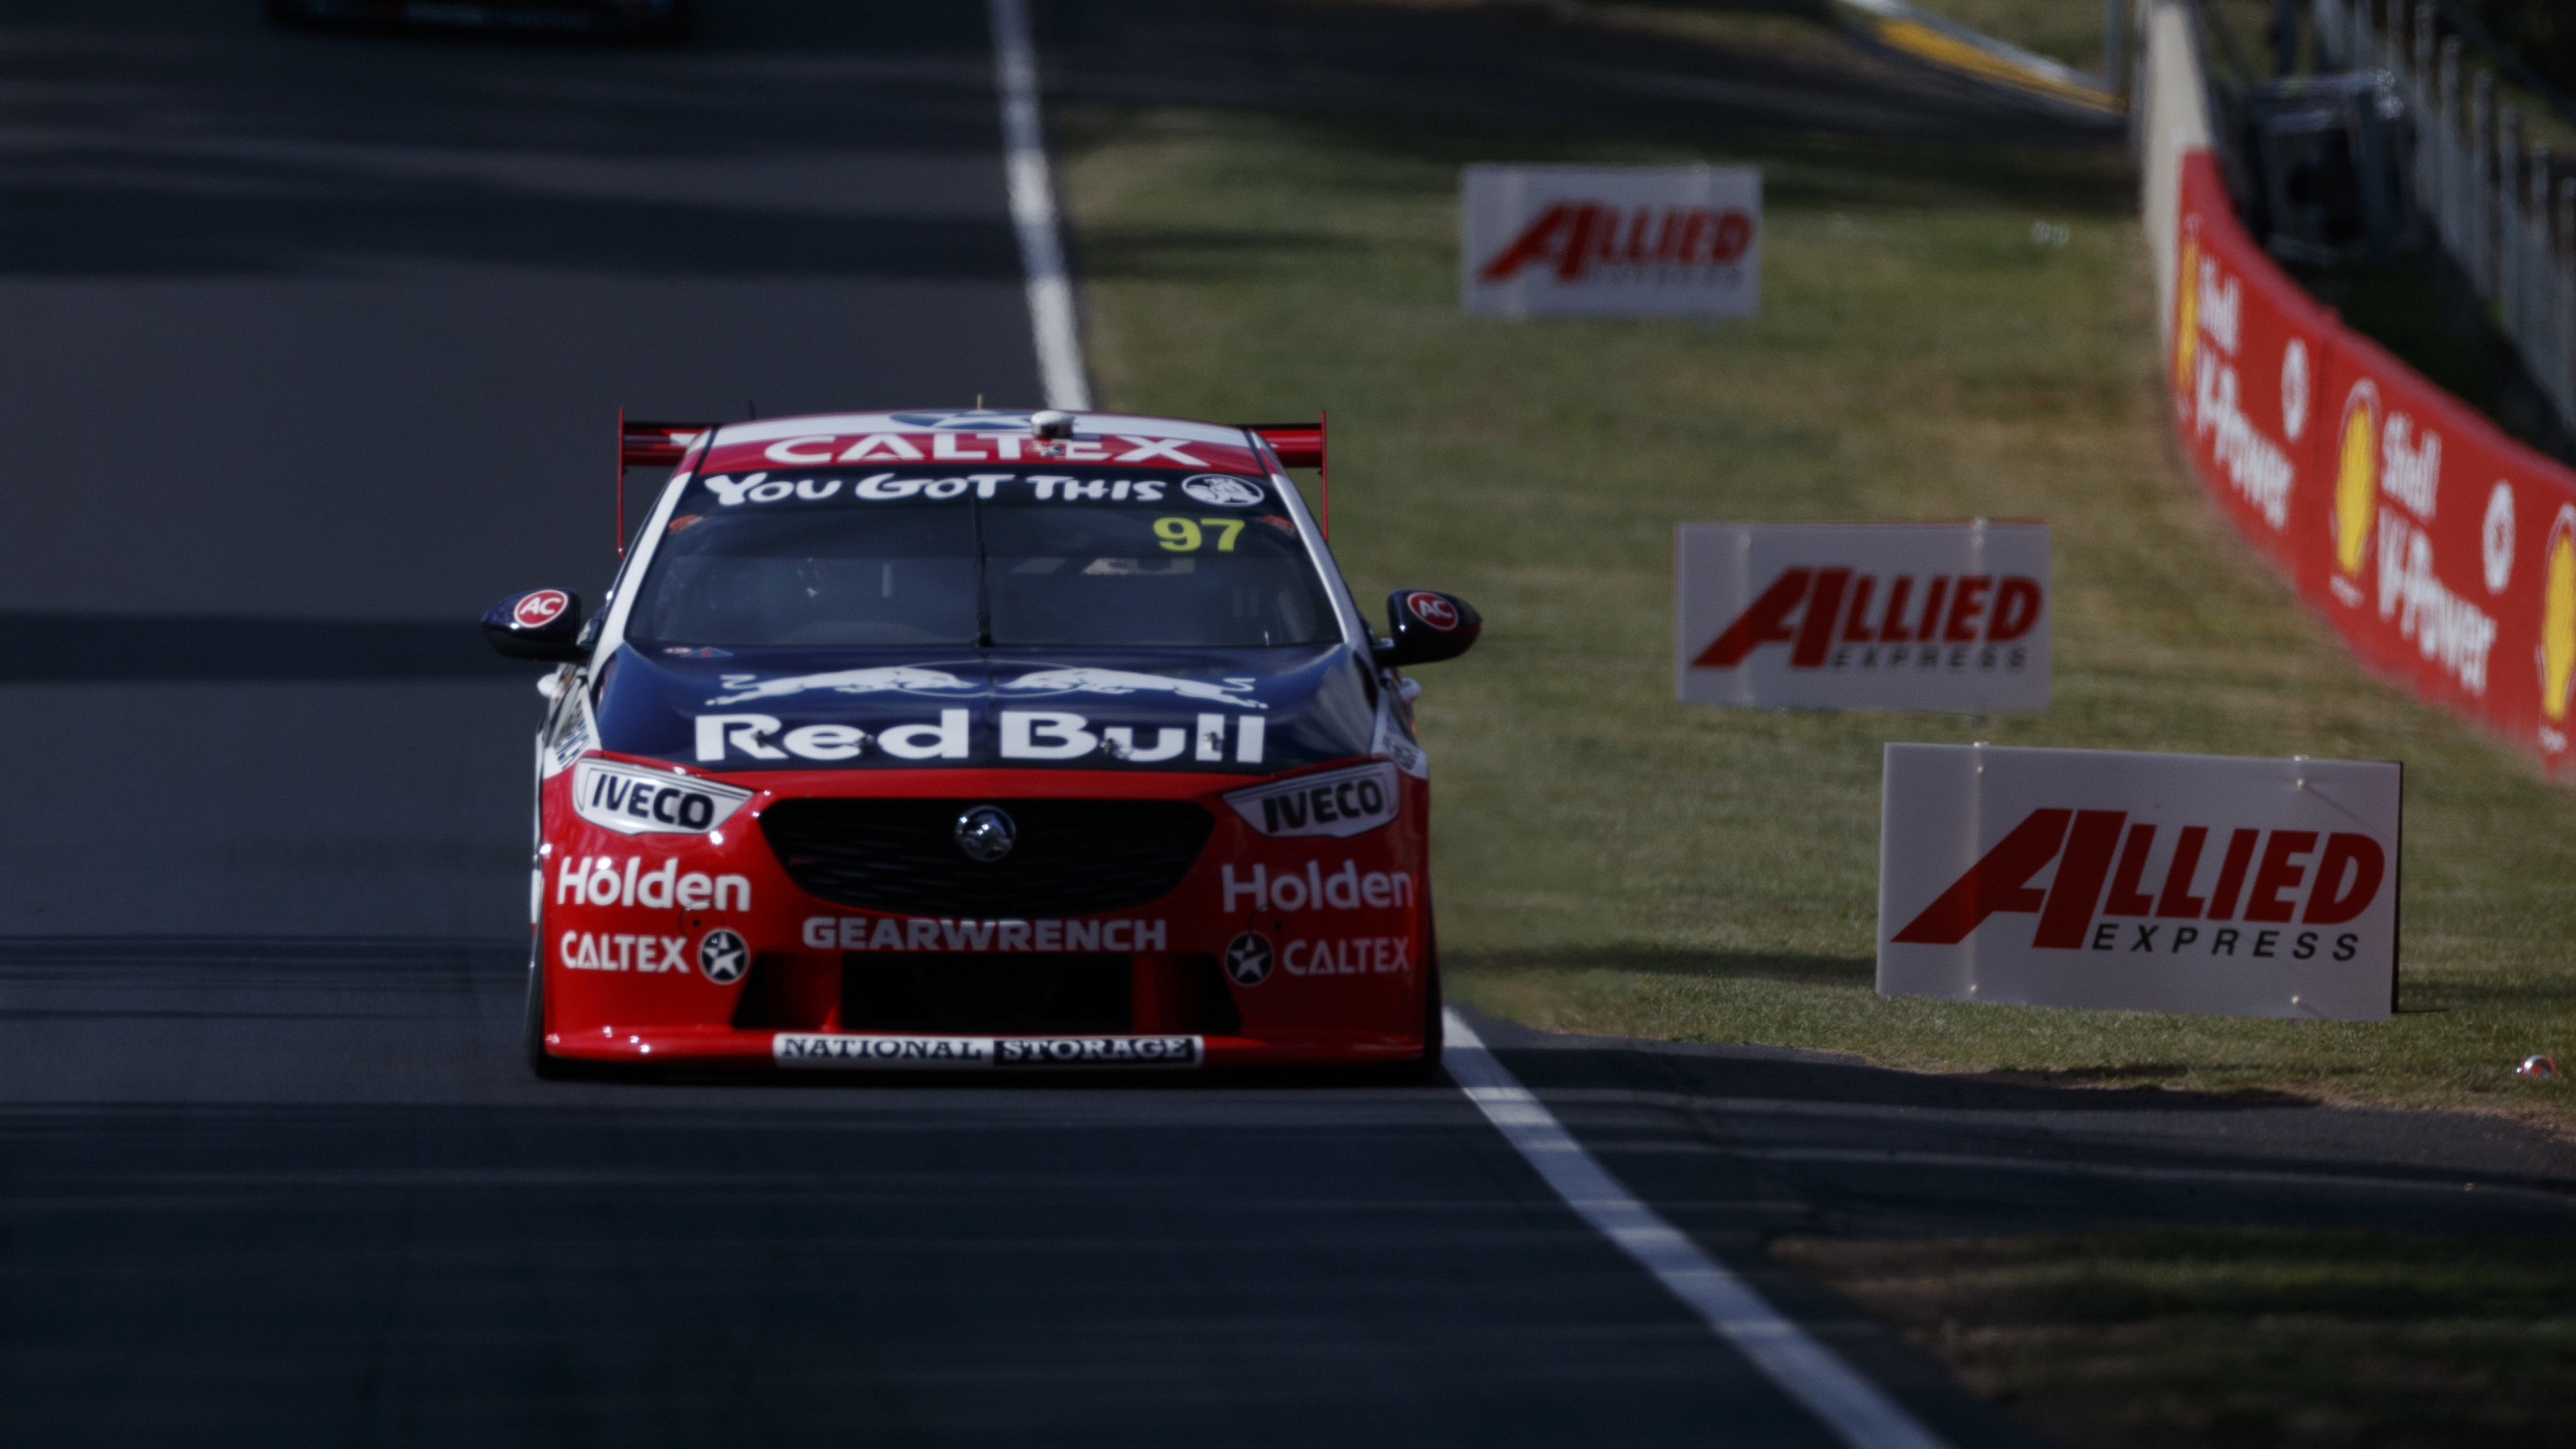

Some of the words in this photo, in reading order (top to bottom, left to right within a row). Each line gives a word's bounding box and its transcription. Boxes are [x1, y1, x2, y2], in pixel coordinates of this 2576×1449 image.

[1477, 201, 1754, 285] ALLIED
[764, 432, 1211, 468] CALTEX
[1025, 474, 1167, 501] THIS
[1153, 517, 1245, 552] 97
[519, 596, 560, 615] AC
[1418, 598, 1454, 621] AC
[1689, 567, 2043, 668] ALLIED
[1833, 645, 2030, 670] EXPRESS
[695, 708, 969, 761] Red
[999, 710, 1266, 763] Bull
[592, 774, 714, 830] IVECO
[1262, 779, 1383, 833] IVECO
[556, 855, 752, 913] Holden
[1220, 859, 1415, 914] Holden
[1889, 808, 2385, 949] ALLIED
[559, 929, 692, 974] CALTEX
[801, 915, 1167, 952] GEARWRENCH
[2091, 923, 2359, 961] EXPRESS
[1282, 935, 1411, 977] CALTEX
[783, 1037, 983, 1062] NATIONAL
[1000, 1038, 1188, 1062] STORAGE
